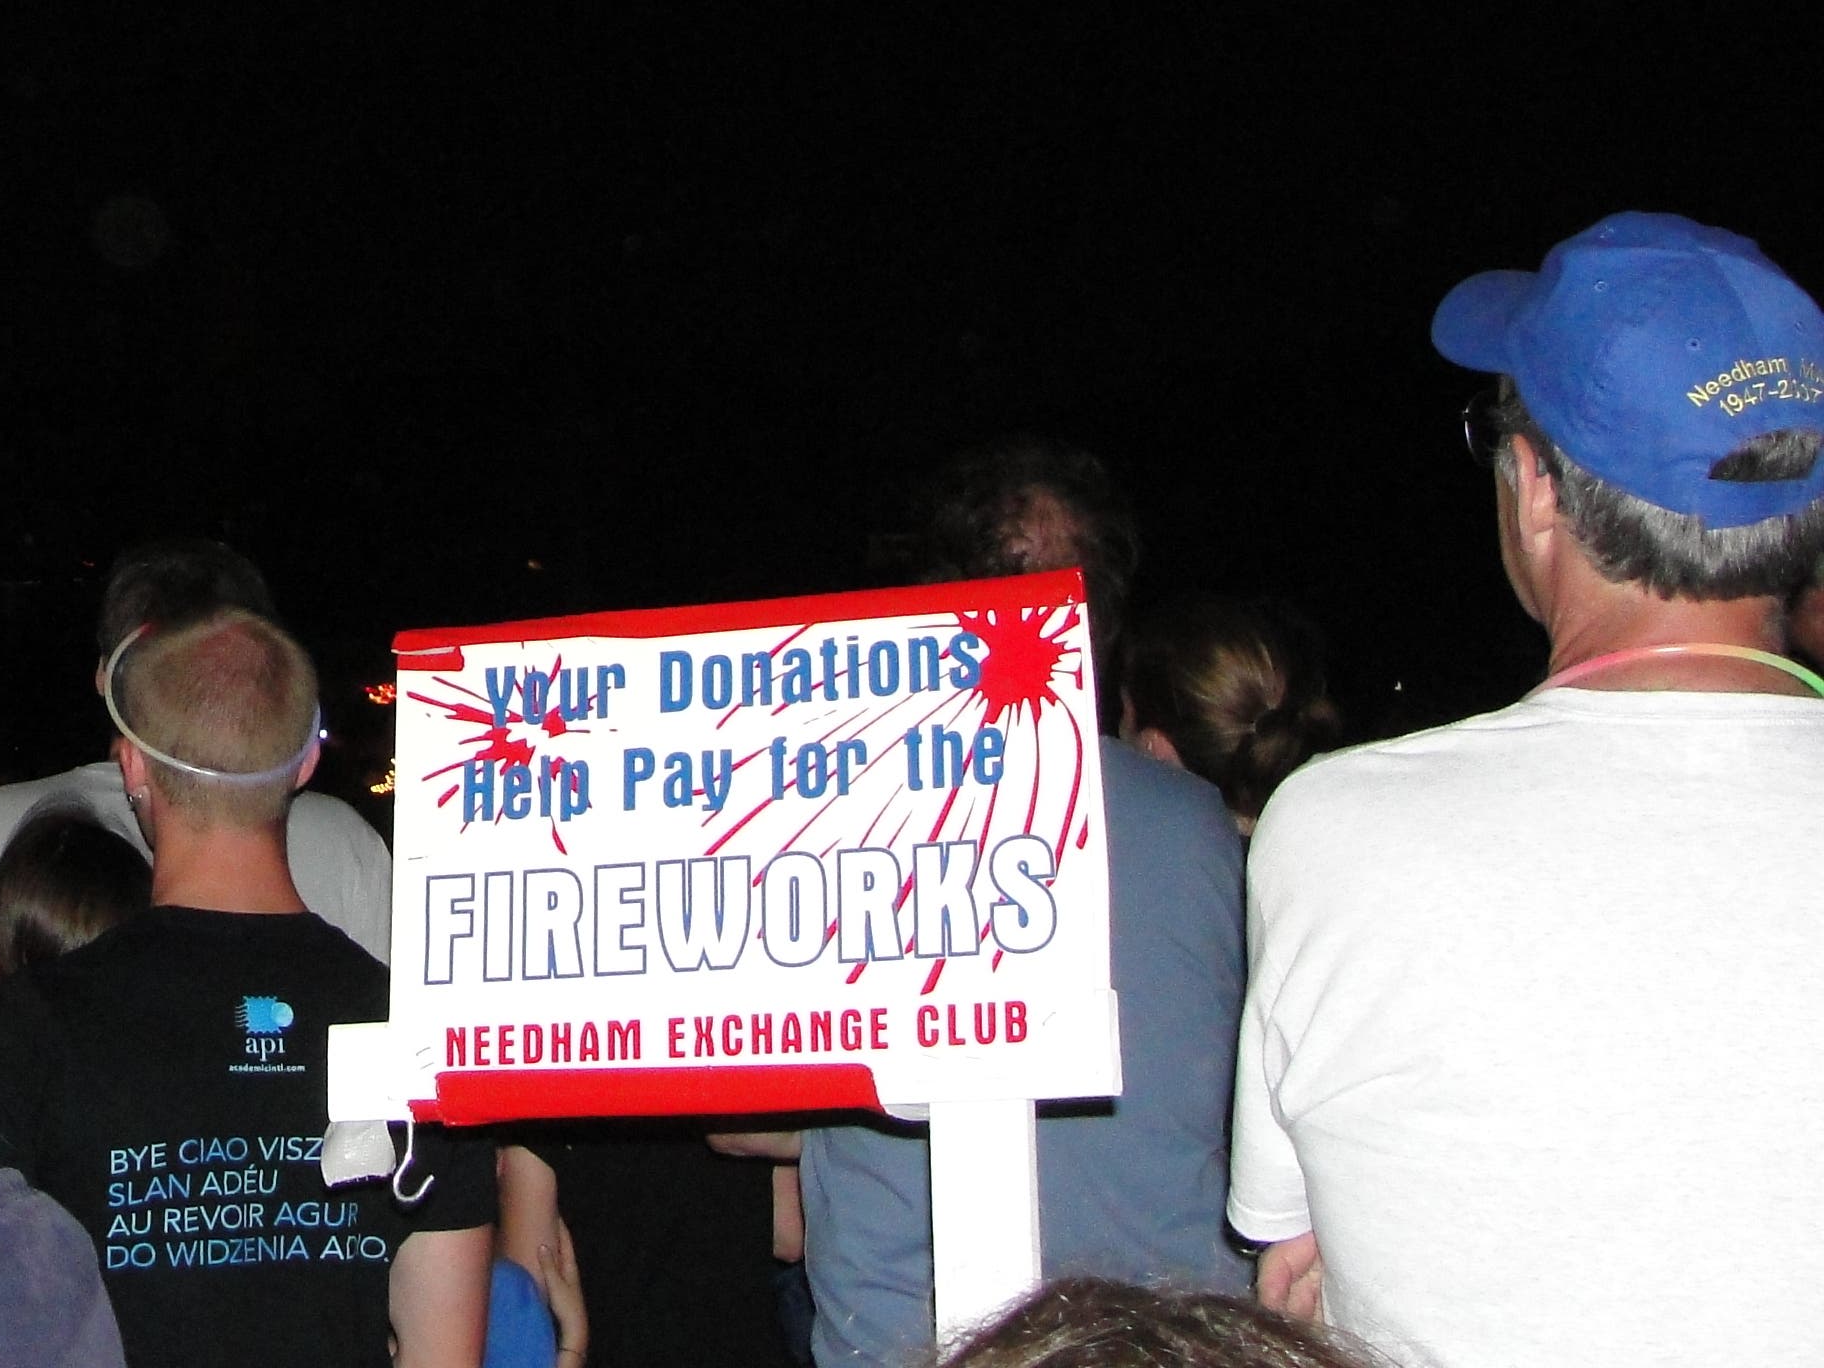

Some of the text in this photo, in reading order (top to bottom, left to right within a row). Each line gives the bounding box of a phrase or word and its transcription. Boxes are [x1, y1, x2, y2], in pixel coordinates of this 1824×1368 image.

[1686, 357, 1788, 408] Needham
[485, 633, 982, 728] Your Donations
[462, 724, 1005, 822] Help Pay for the
[423, 834, 1057, 985] FIREWORKS
[245, 1037, 285, 1062] api
[445, 1000, 1028, 1068] NEEDHAM EXCHANGE CLUB
[110, 1143, 167, 1174] BYE
[179, 1137, 248, 1164] CIAO
[108, 1163, 278, 1207] SLAN ADÉU
[106, 1201, 359, 1238] AU REVOIR AGUR
[106, 1242, 156, 1269] DO
[166, 1234, 309, 1268] WIDZENIA
